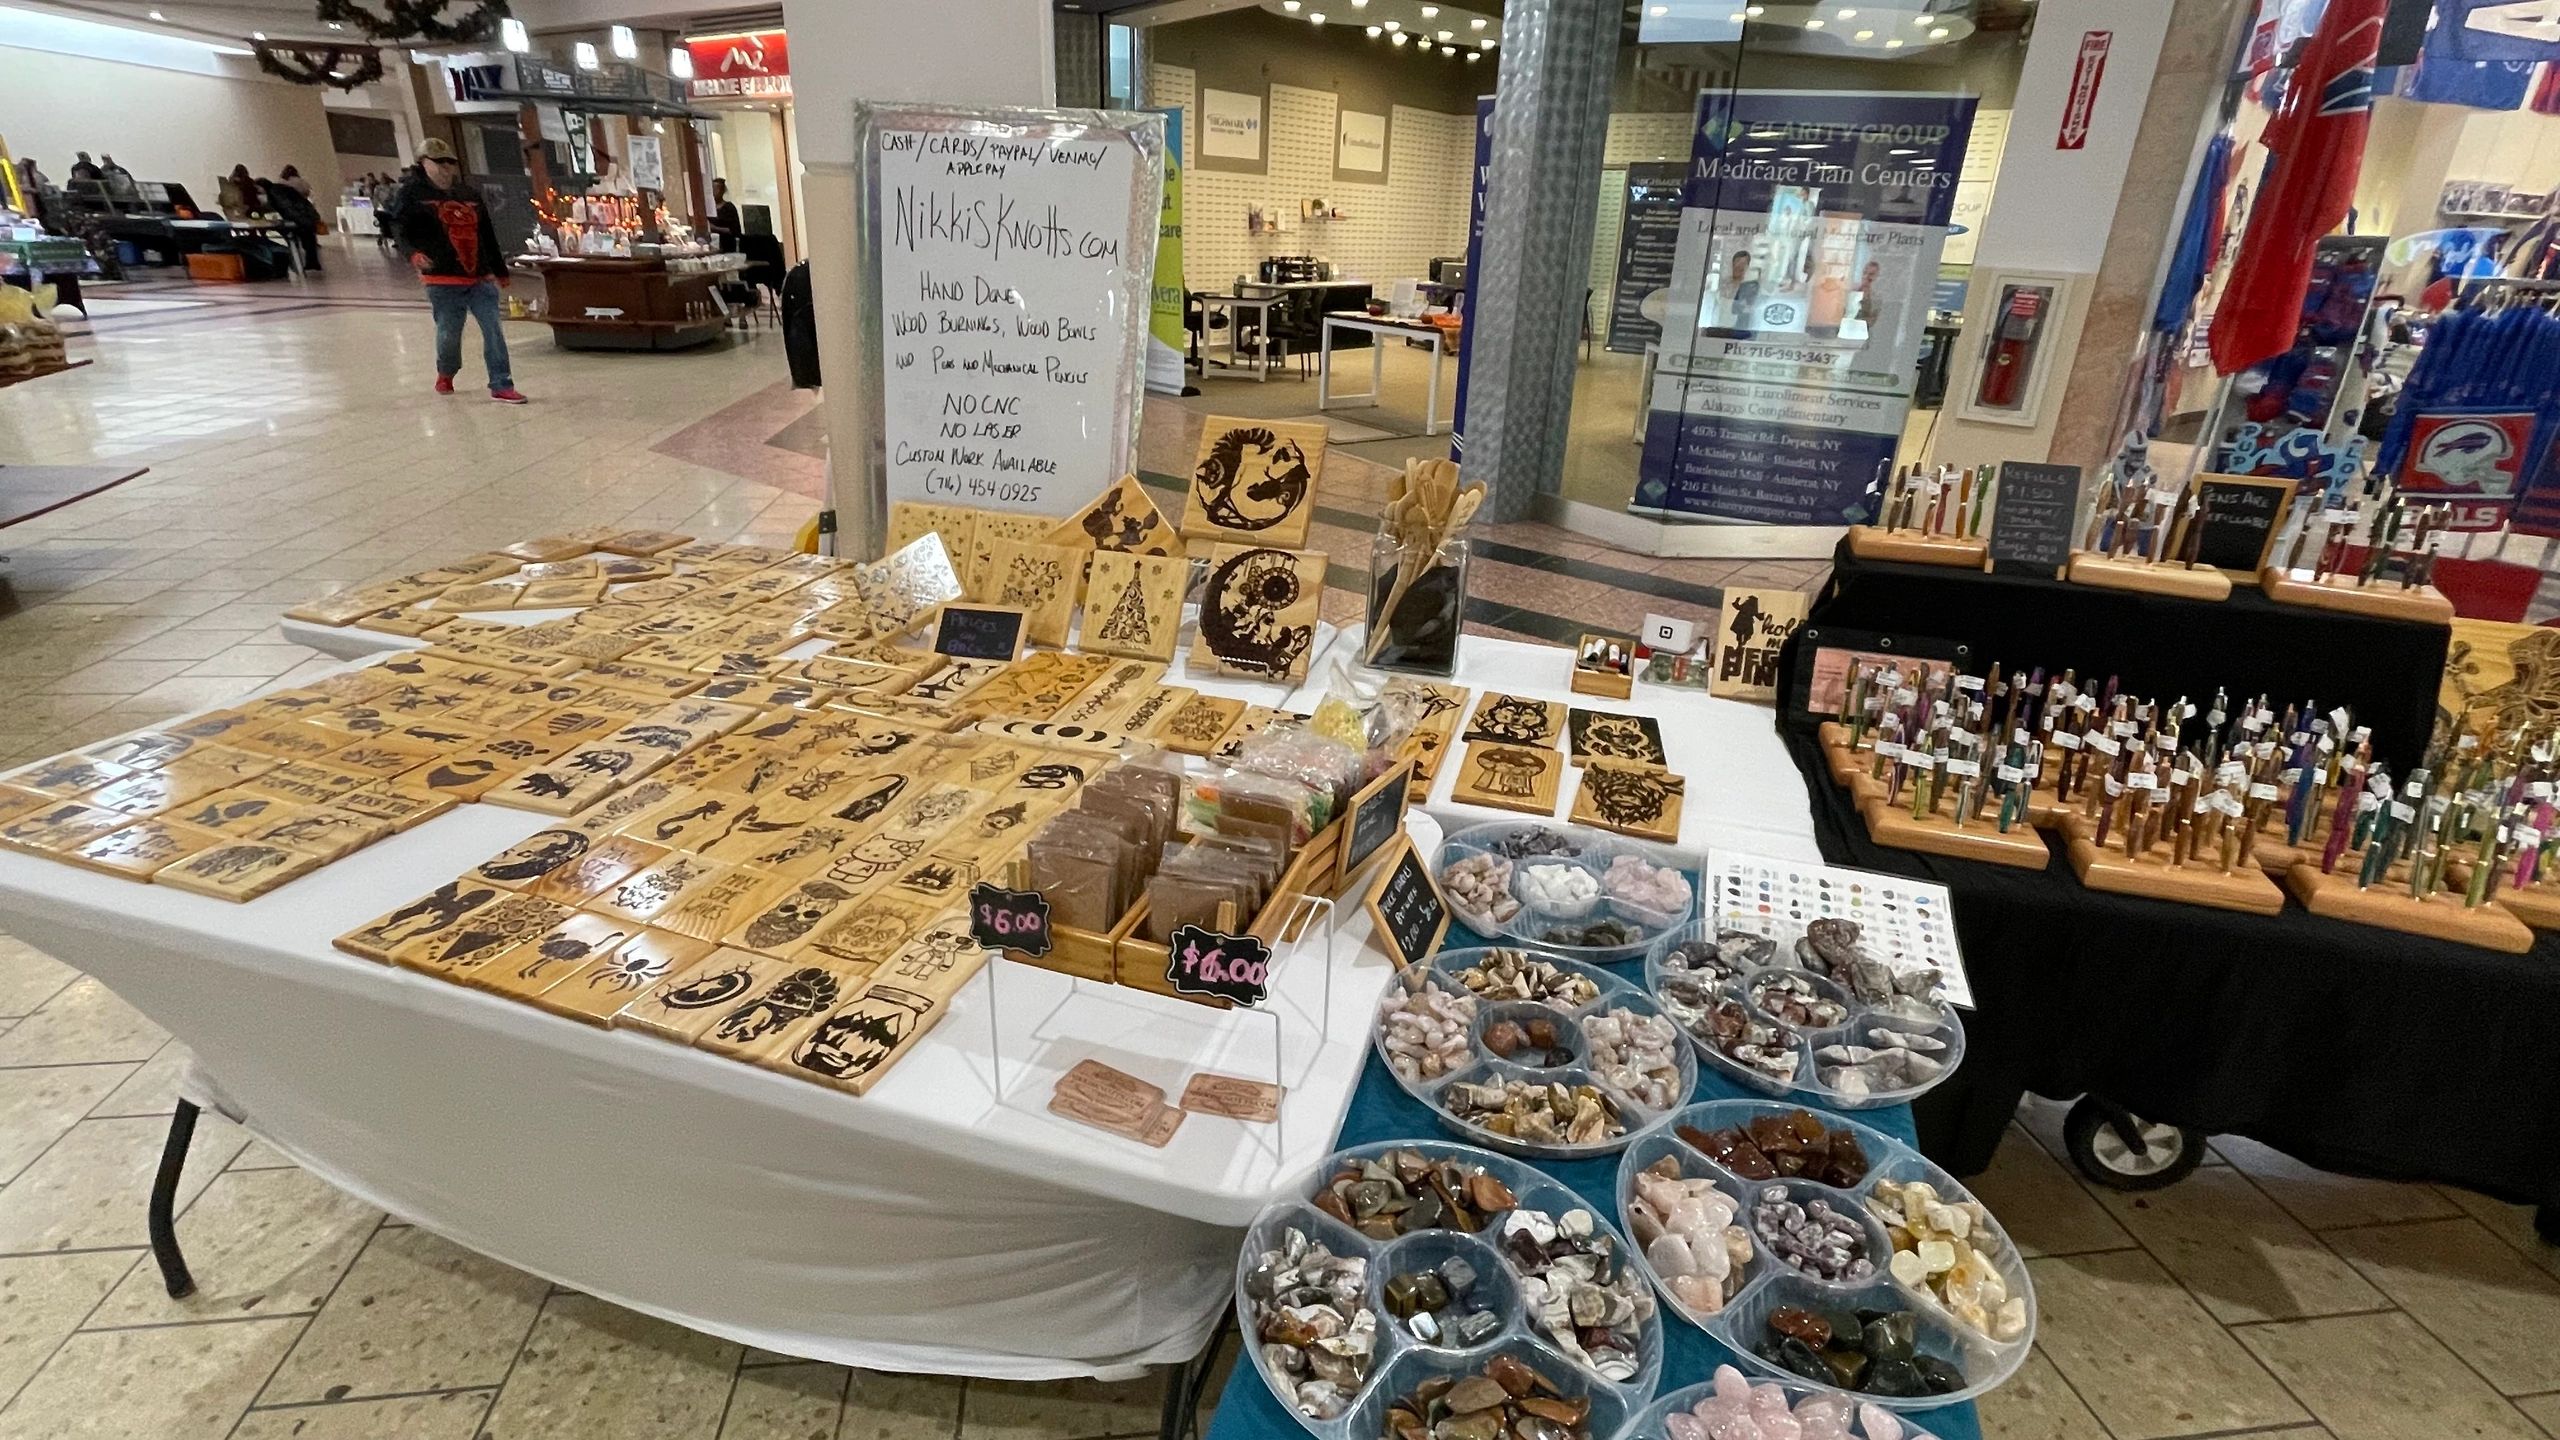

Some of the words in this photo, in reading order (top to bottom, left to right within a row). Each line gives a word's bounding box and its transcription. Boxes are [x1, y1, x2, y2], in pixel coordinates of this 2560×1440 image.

[2085, 39, 2106, 51] FIRE
[1860, 125, 1949, 145] GROUP
[1696, 157, 1797, 181] Medicare
[1805, 161, 1853, 184] Plan
[1861, 163, 1951, 188] Centers
[1697, 220, 1734, 236] Local
[1737, 222, 1760, 236] and
[1887, 232, 1925, 246] Plans
[920, 270, 964, 302] HAND
[892, 312, 928, 338] WOOD
[1016, 315, 1050, 340] WOOD
[1058, 316, 1097, 343] BOWLS
[1749, 346, 1838, 366] 716-393-3437
[943, 393, 977, 416] NO
[980, 394, 1021, 416] CNC
[1676, 380, 1748, 397] Professional
[1754, 386, 1824, 405] Enrollment
[1827, 394, 1882, 410] Services
[1701, 398, 1746, 414] Always
[1748, 404, 1848, 425] Complimentary
[940, 422, 966, 438] NO
[973, 423, 1022, 440] LASER
[1720, 427, 1756, 443] Transit
[1822, 440, 1842, 452] NY
[895, 440, 945, 467] CUSTOM
[951, 447, 985, 467] WORK
[992, 449, 1058, 476] AVAILABLE
[1740, 450, 1764, 464] Mall
[1820, 460, 1841, 472] NY
[925, 468, 962, 496] (716)
[1684, 462, 1737, 478] Boulevard
[1740, 468, 1763, 482] Mall
[1822, 479, 1843, 492] NY
[1799, 495, 1819, 507] NY
[980, 903, 1042, 935] $6.00
